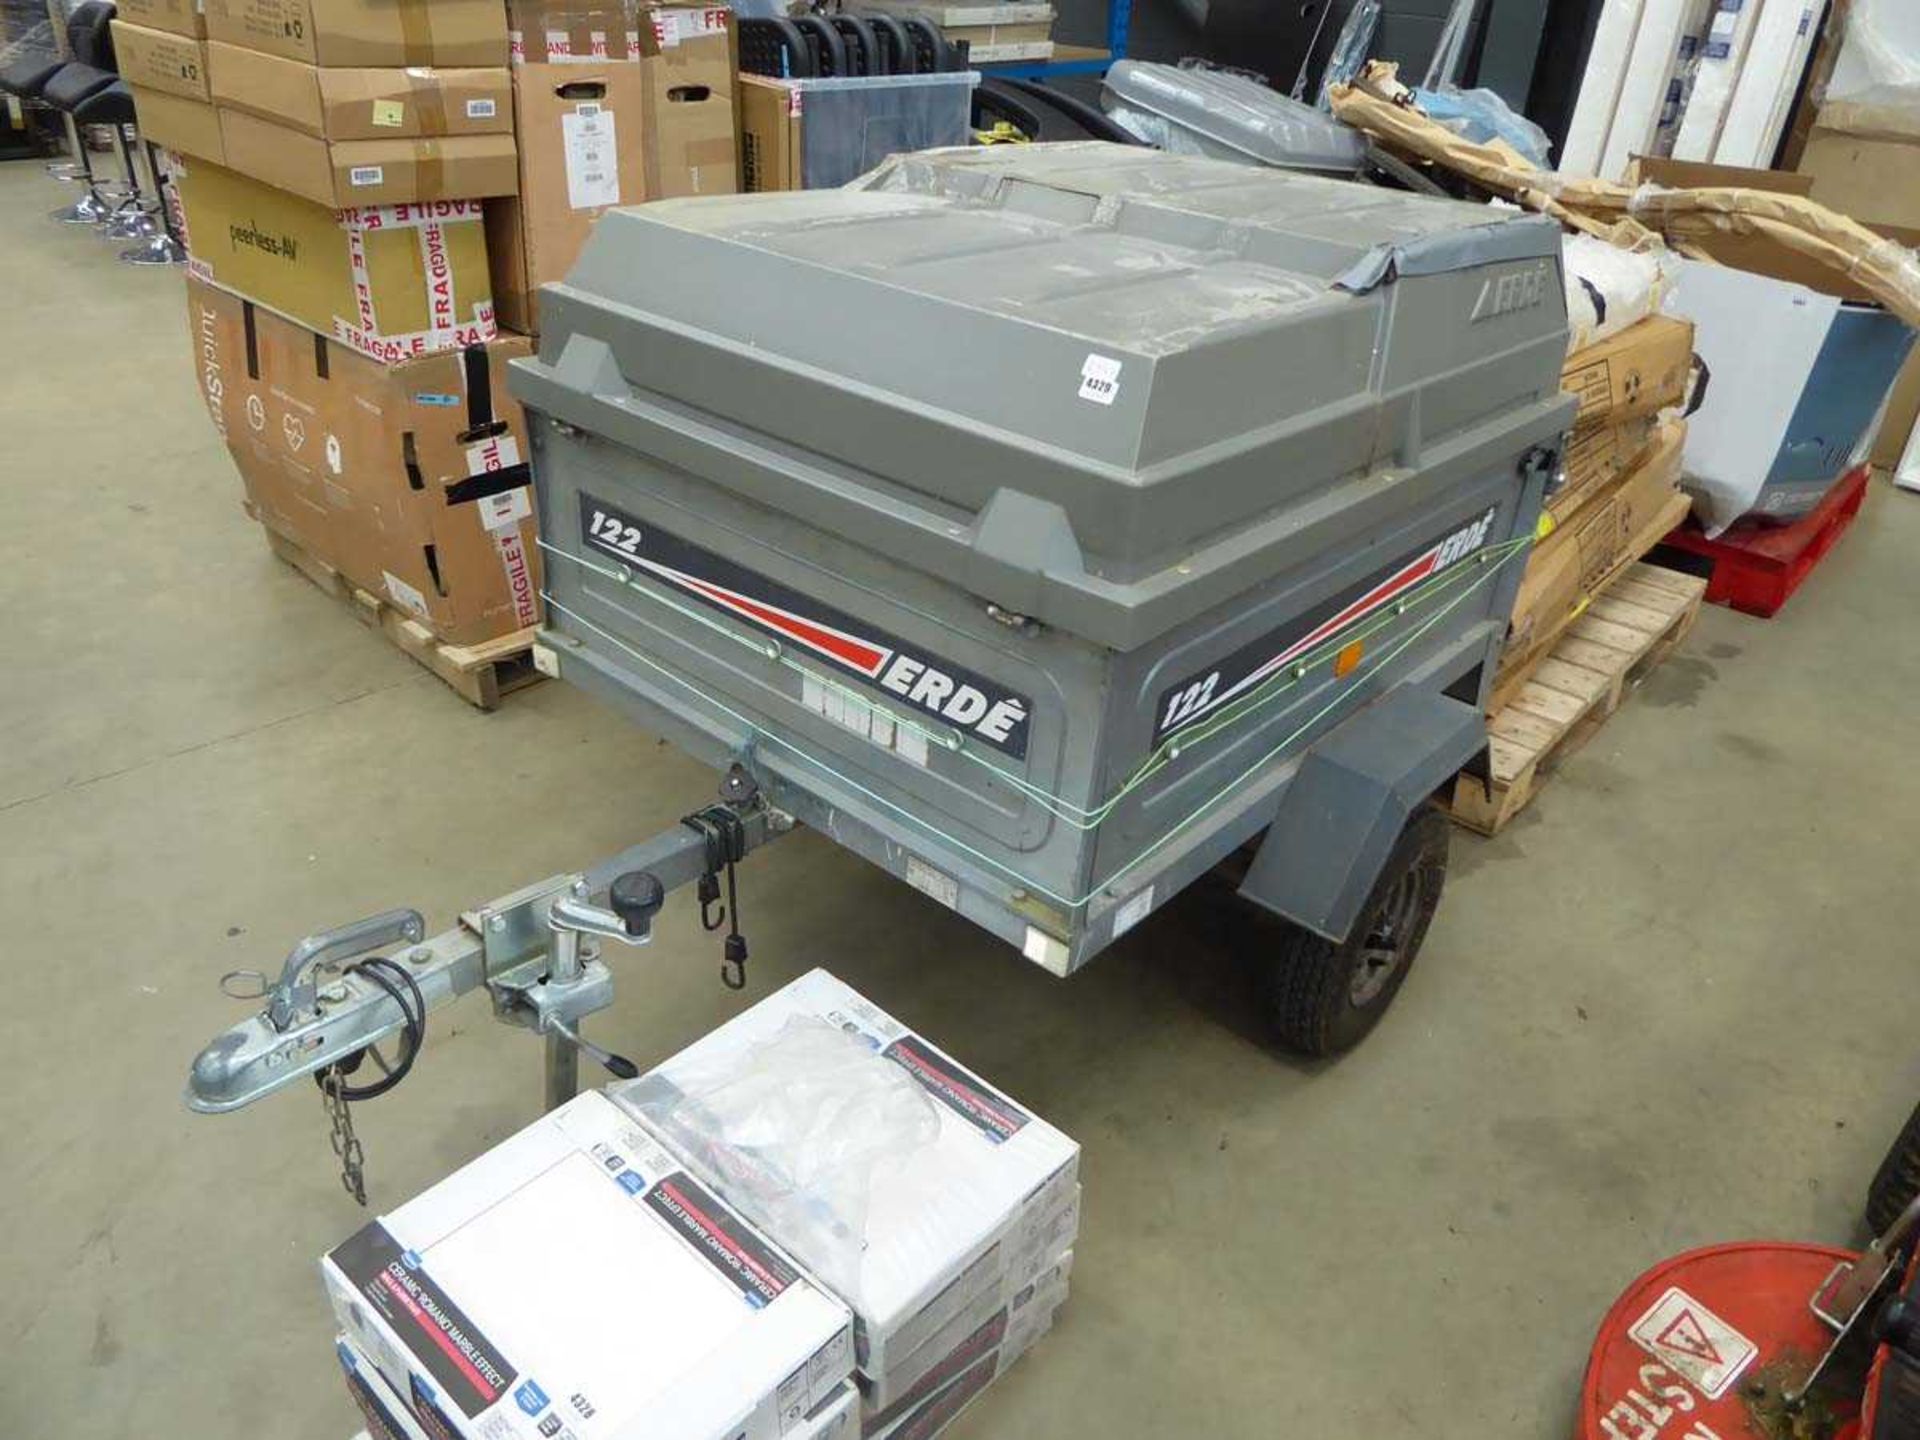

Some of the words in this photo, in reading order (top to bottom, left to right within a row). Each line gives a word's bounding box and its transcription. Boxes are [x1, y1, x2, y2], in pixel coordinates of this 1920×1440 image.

[229, 218, 297, 262] peerless-AV
[1086, 377, 1113, 393] 4329
[589, 511, 642, 553] 122
[1160, 671, 1220, 730] 122
[388, 1261, 422, 1297] CERAMIC
[447, 1326, 481, 1363] MARBLE
[473, 1356, 505, 1389] EFFECT
[570, 1392, 596, 1420] 4328
